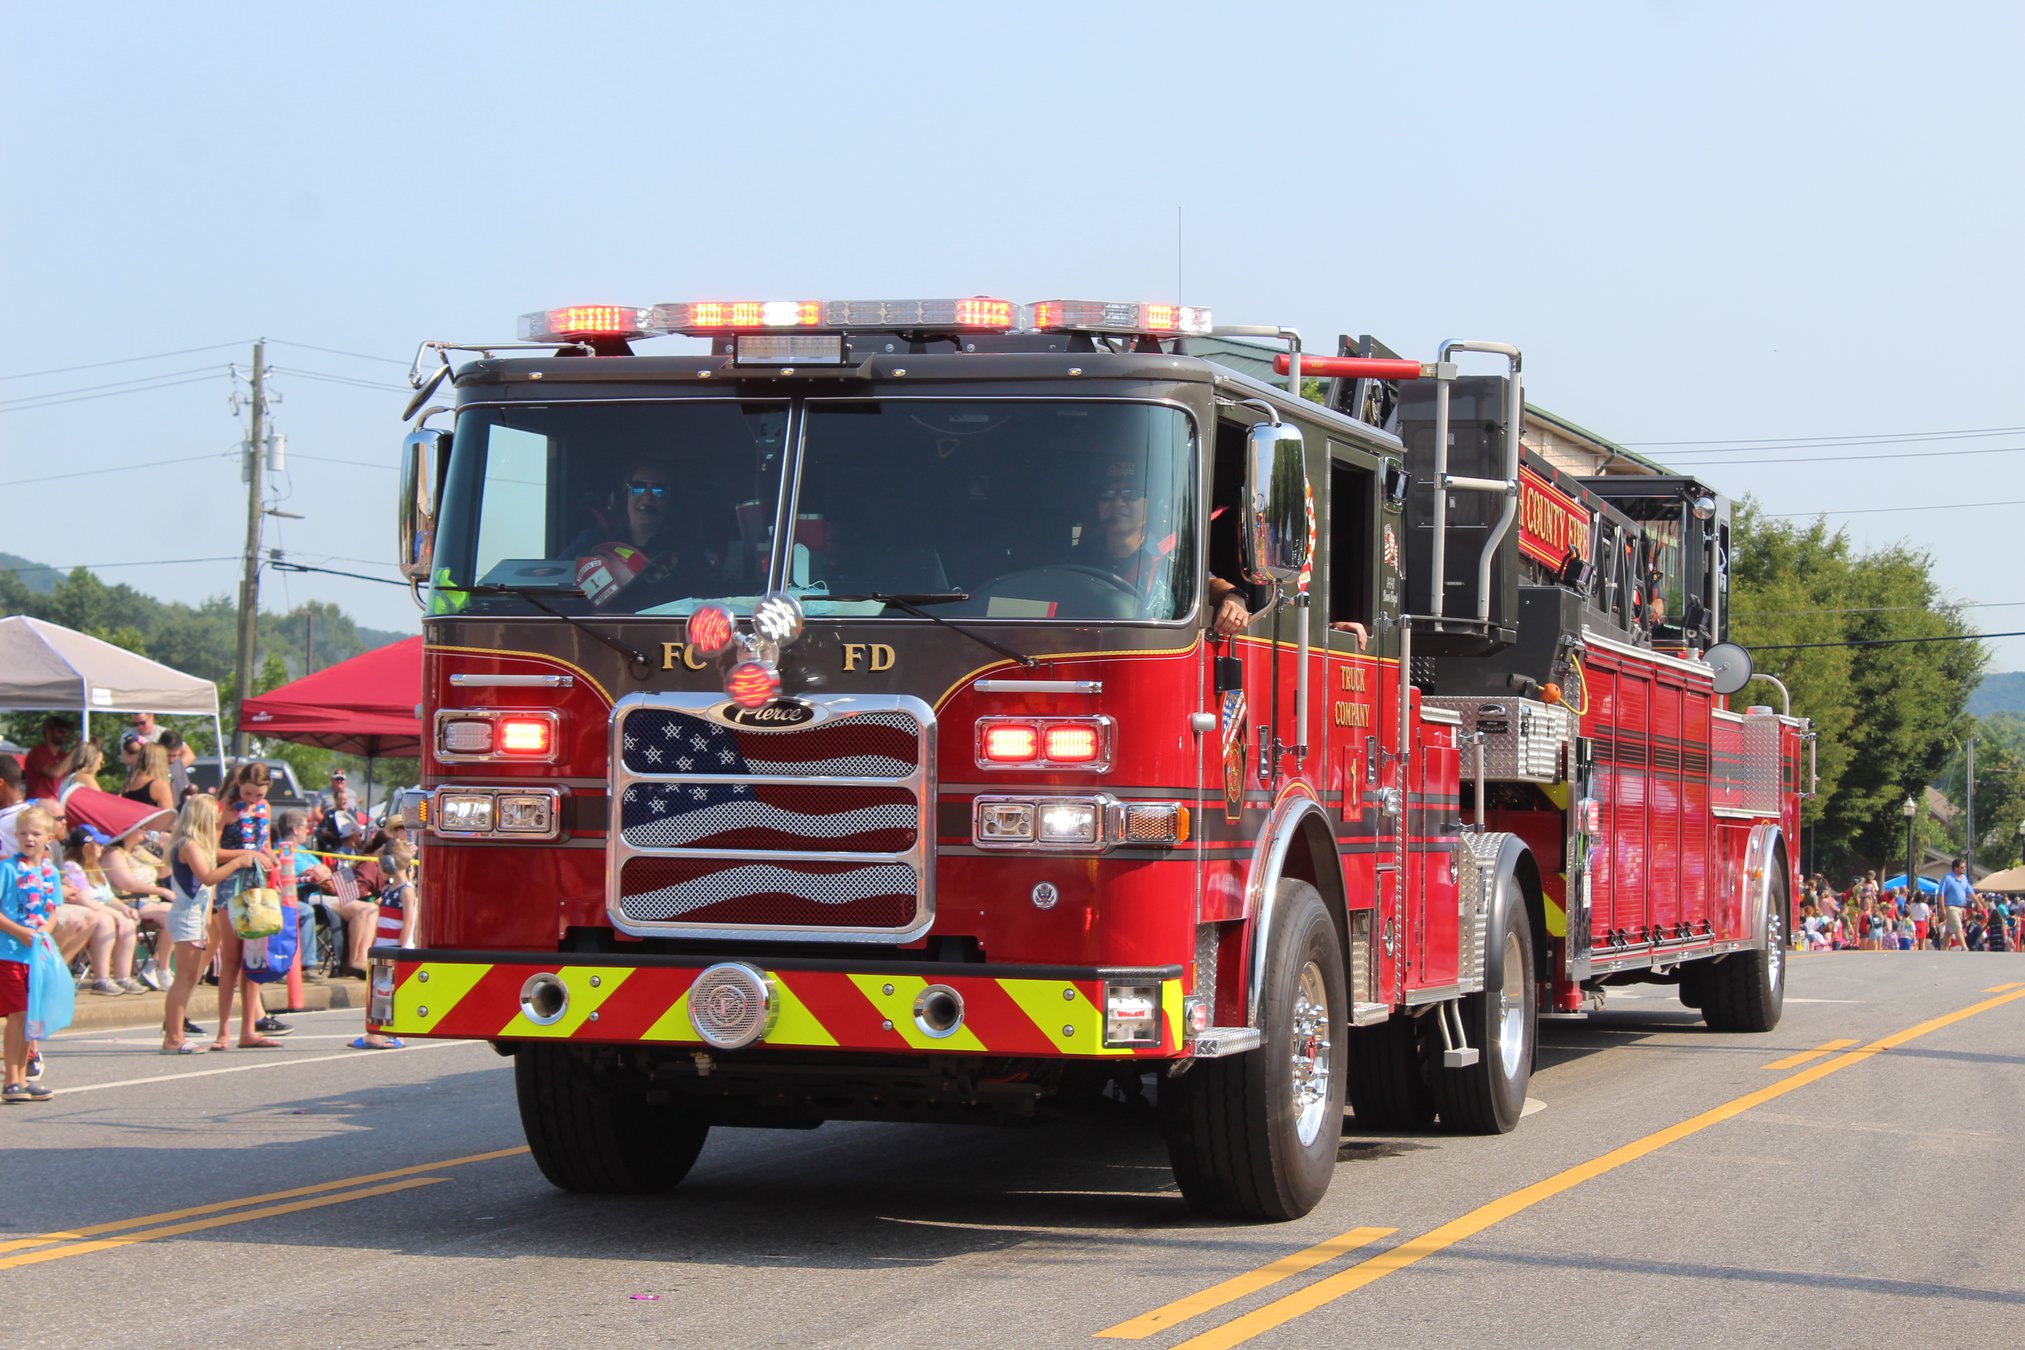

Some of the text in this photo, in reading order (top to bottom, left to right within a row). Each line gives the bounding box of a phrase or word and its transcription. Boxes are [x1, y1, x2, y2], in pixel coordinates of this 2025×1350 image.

[1526, 487, 1567, 552] COUNTY
[1568, 513, 1589, 562] FIRE
[843, 643, 896, 671] FD
[1340, 665, 1366, 692] TRUCK
[1335, 701, 1371, 728] COMPANY
